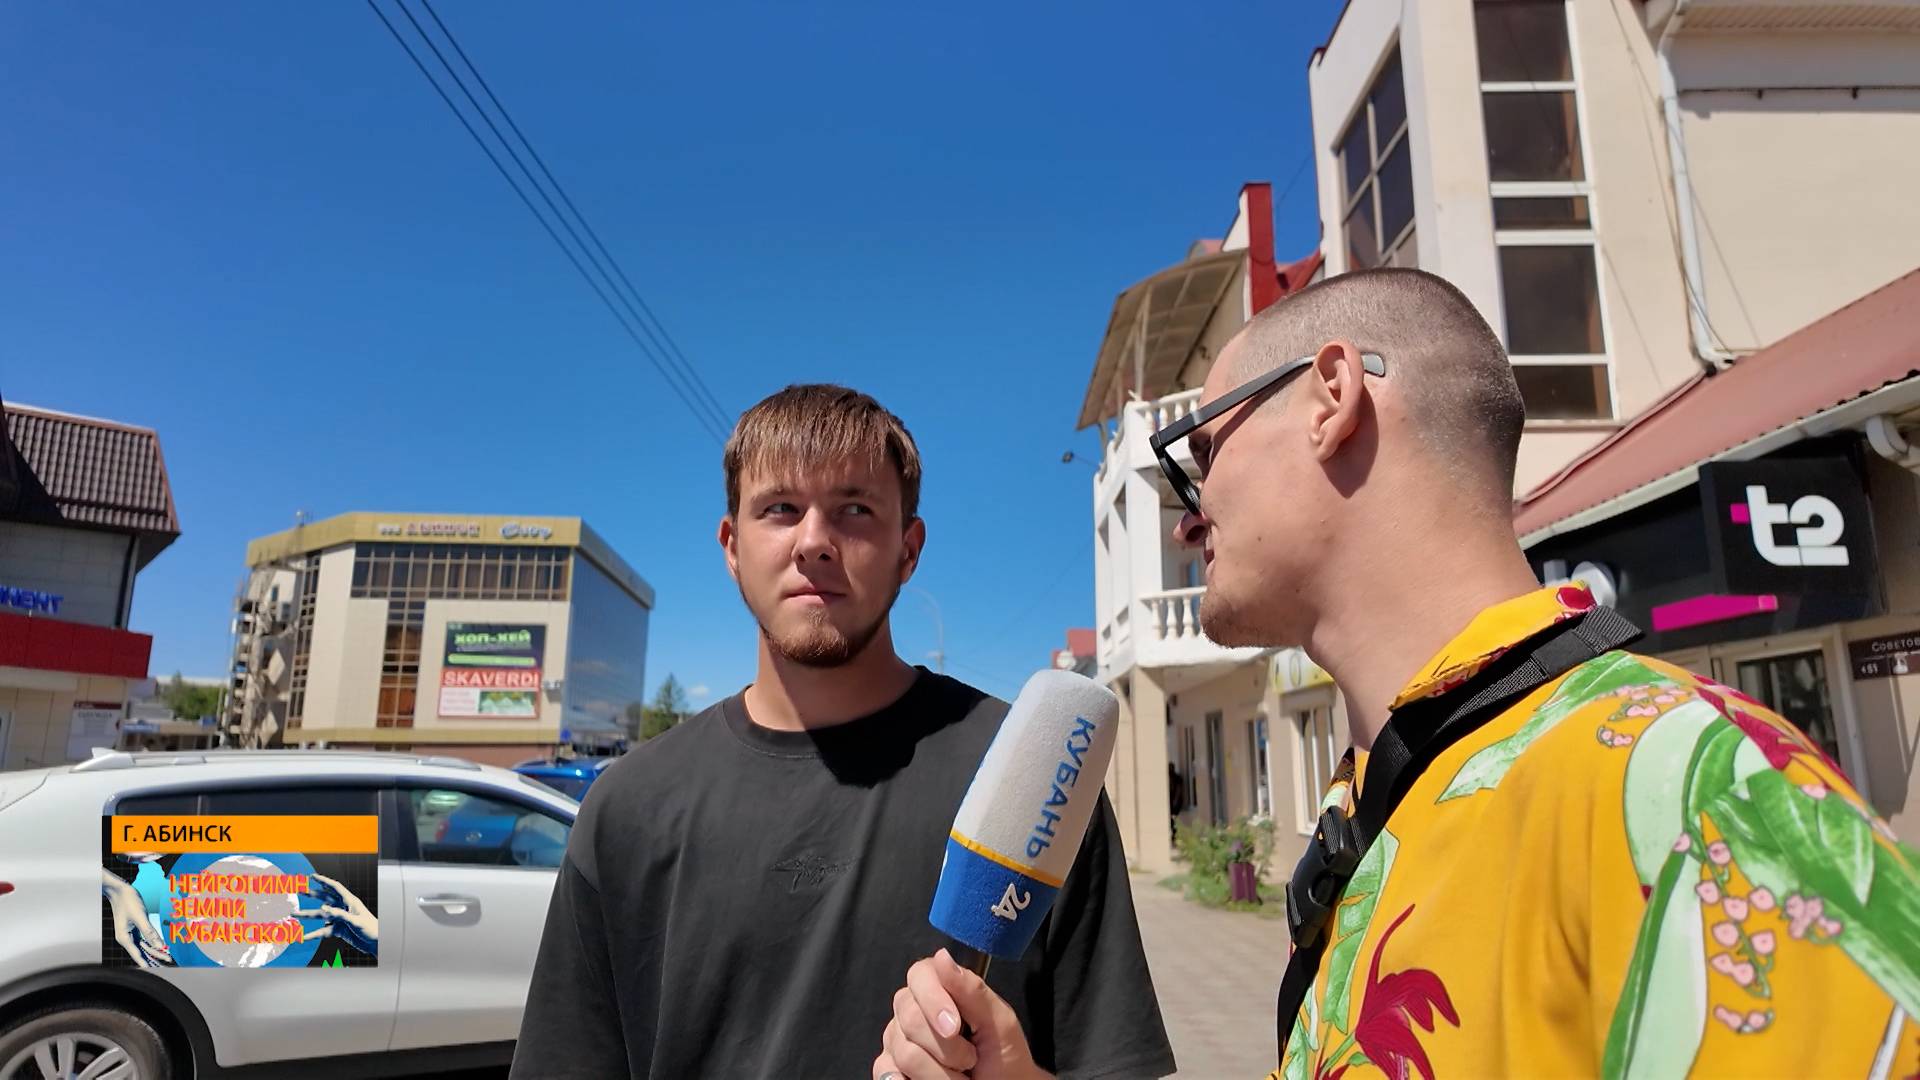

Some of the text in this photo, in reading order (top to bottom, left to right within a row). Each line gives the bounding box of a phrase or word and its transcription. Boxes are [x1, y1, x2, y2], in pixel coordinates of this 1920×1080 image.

[1730, 485, 1850, 567] t2
[444, 671, 539, 686] SKAVERDI
[990, 715, 1096, 922] КУБАНЬ 24
